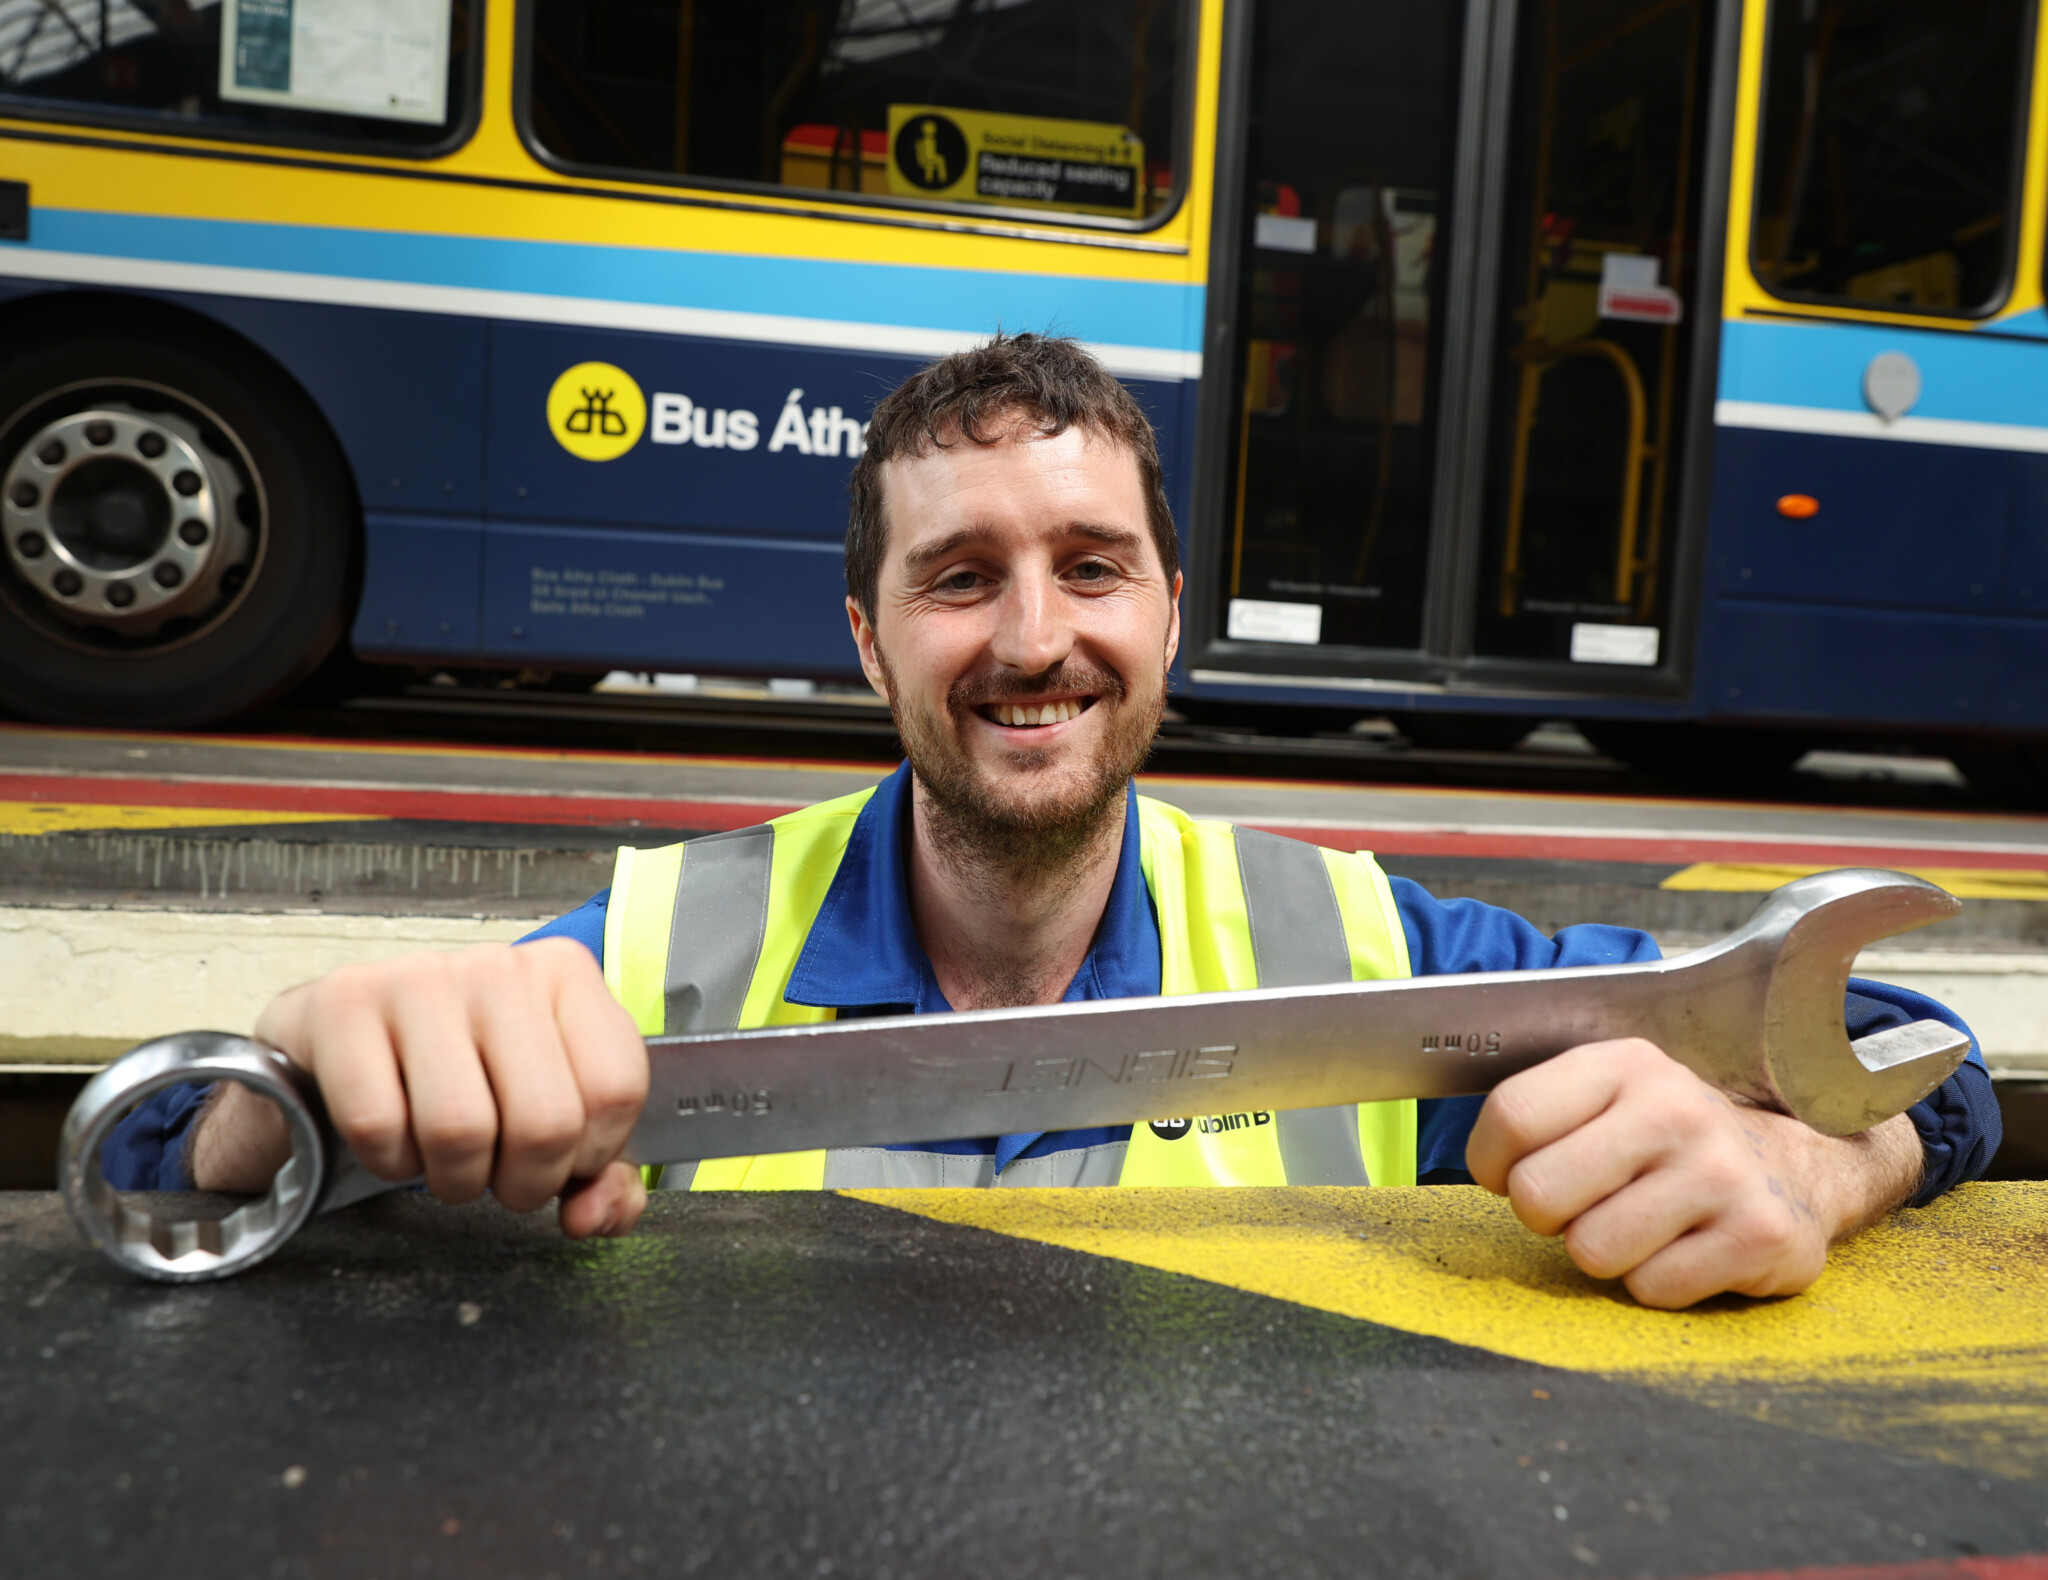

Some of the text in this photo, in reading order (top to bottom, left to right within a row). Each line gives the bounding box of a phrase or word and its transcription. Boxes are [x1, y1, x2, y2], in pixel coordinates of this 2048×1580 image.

[982, 131, 1025, 147] Social
[980, 154, 1130, 192] Reduced seating
[978, 177, 1058, 203] capacity
[651, 388, 873, 458] Bus Áth
[1421, 1032, 1501, 1056] 50mm
[984, 1044, 1238, 1097] SIGNET
